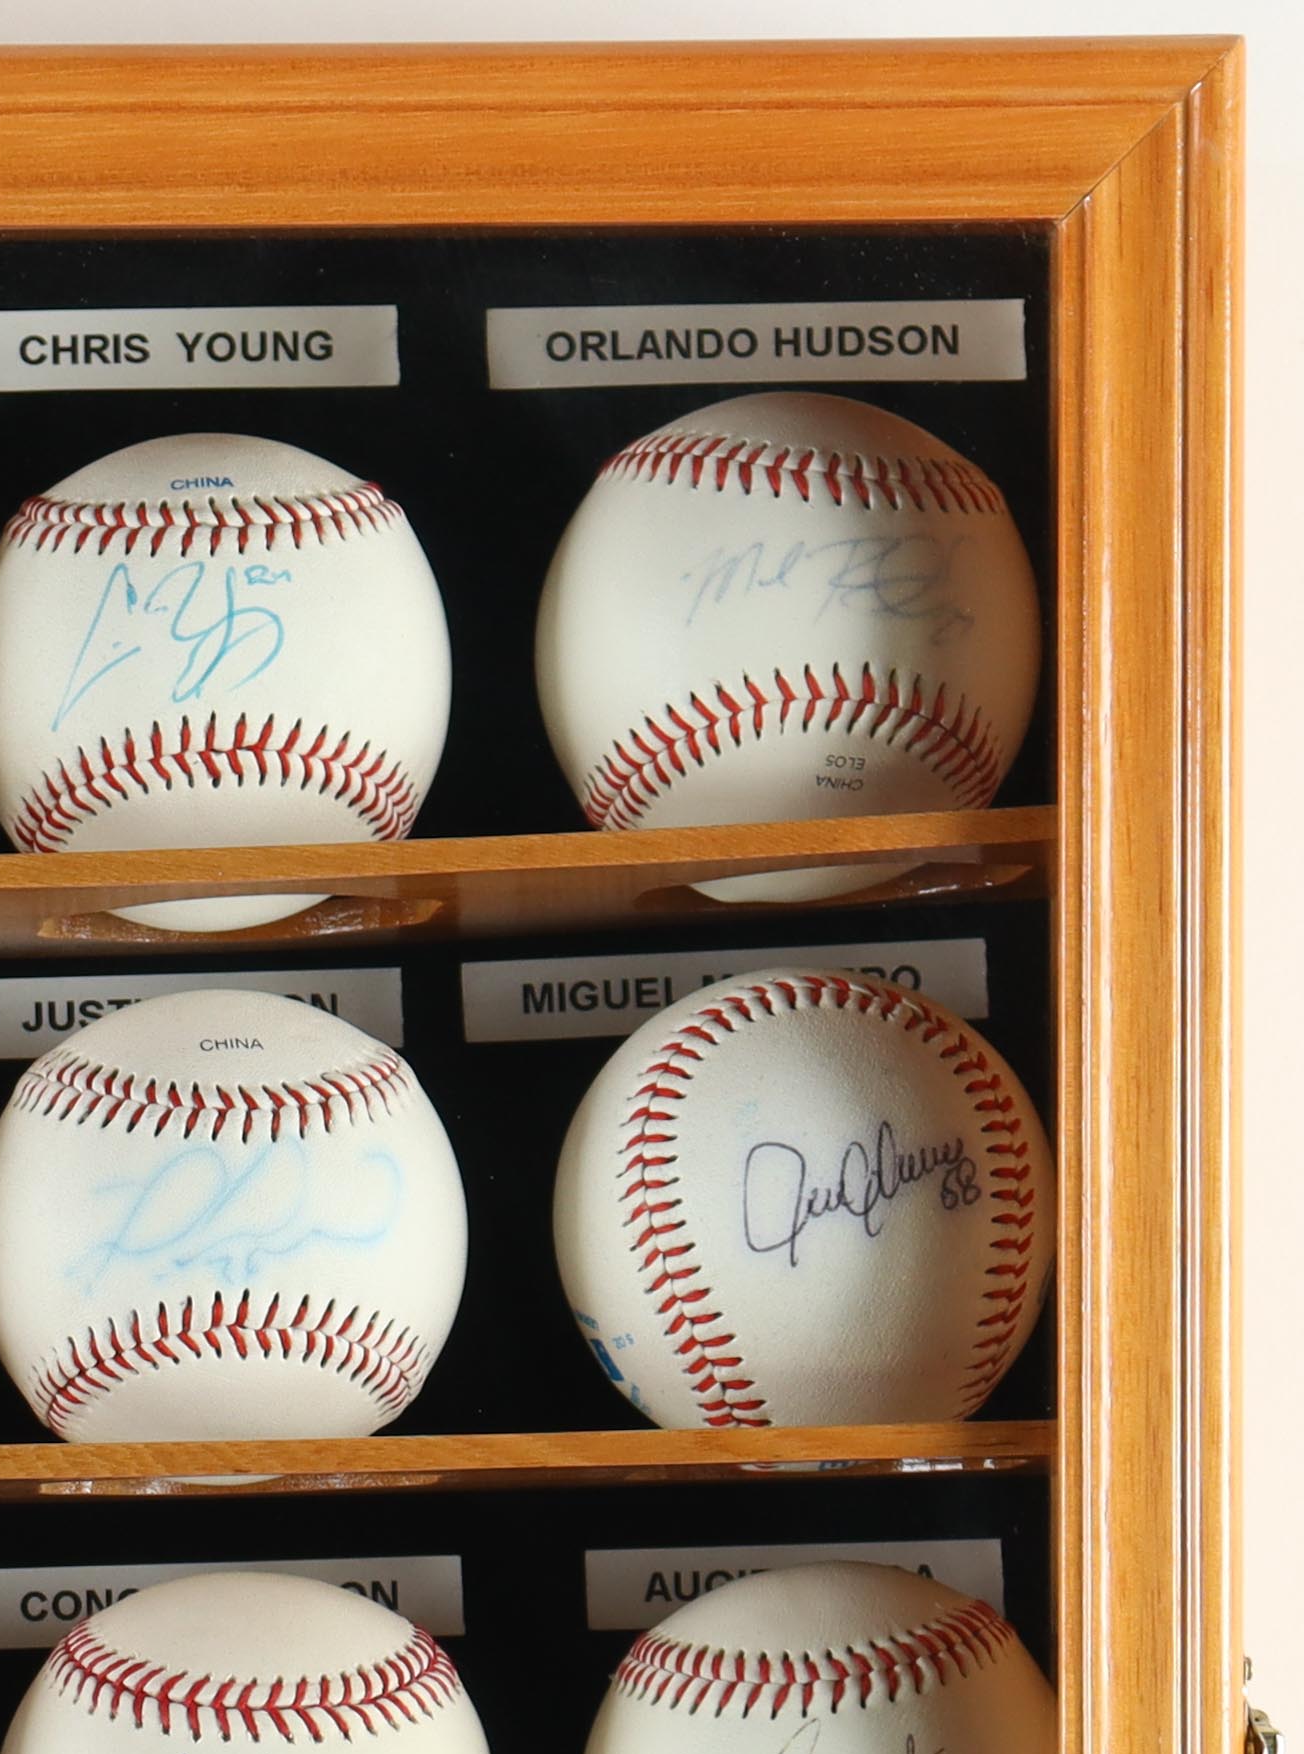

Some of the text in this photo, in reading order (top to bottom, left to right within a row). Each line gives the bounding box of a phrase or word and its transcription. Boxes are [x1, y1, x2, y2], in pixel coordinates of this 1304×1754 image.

[19, 330, 333, 366] CHRIS YOUNG
[545, 324, 959, 362] ORLANDO HUDSON
[170, 476, 235, 491] CHINA
[815, 774, 864, 792] CHINA
[199, 1037, 265, 1052] CHINA
